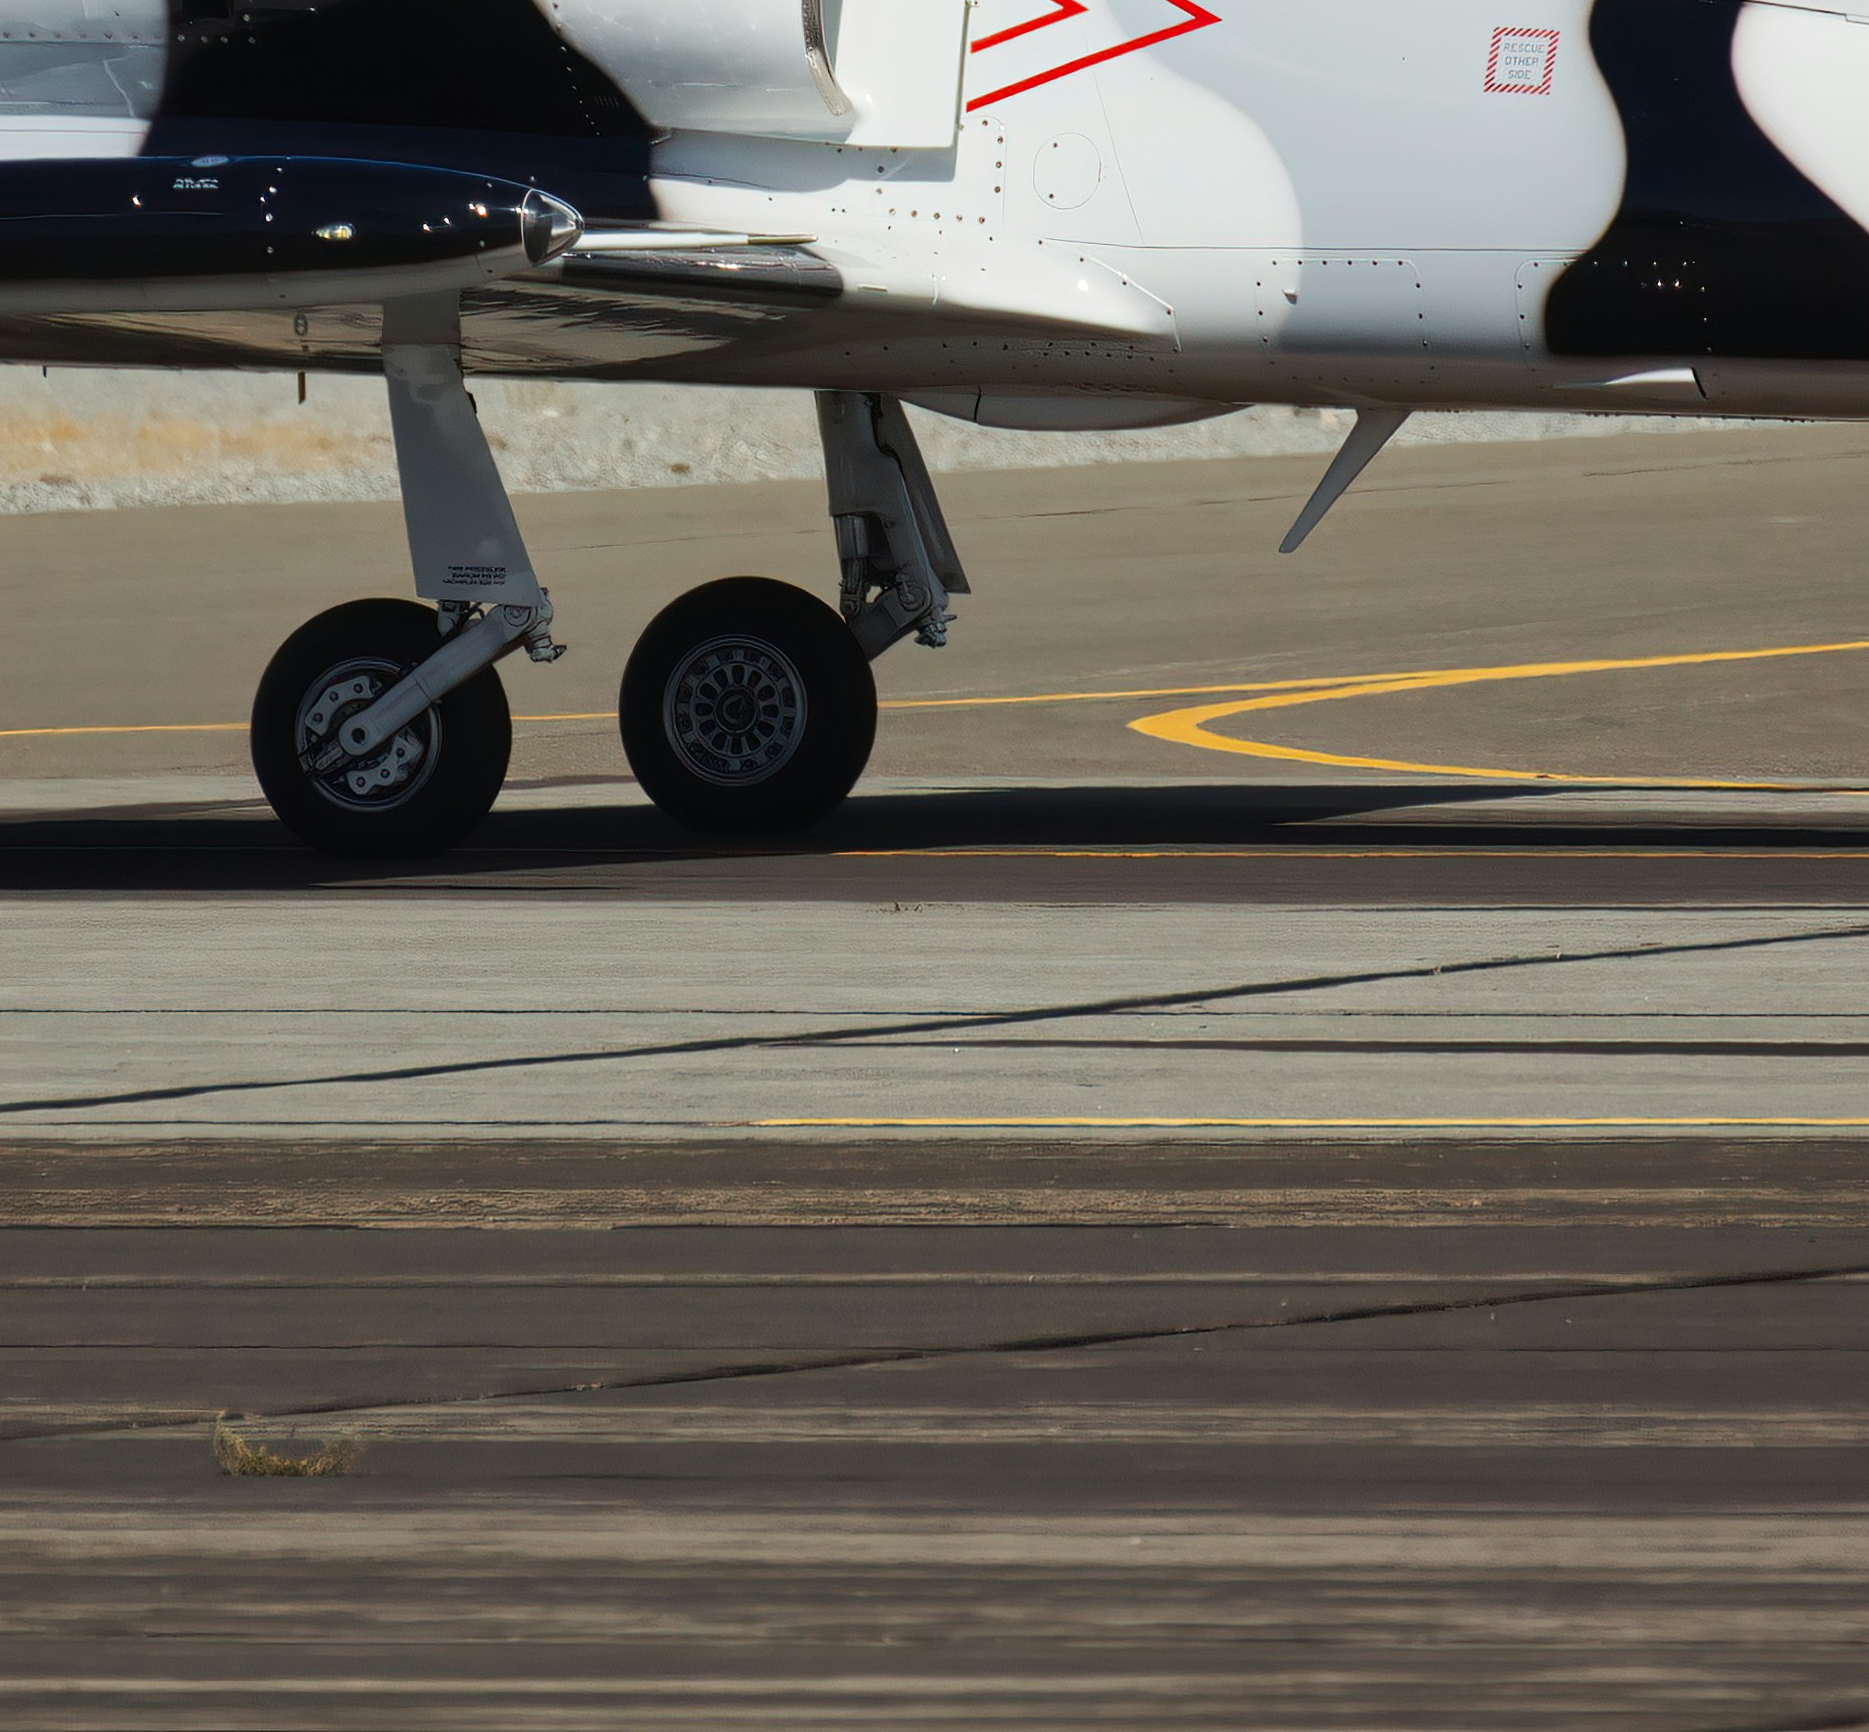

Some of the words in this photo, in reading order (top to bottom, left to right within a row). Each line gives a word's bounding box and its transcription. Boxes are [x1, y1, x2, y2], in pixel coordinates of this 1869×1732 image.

[1502, 42, 1545, 54] RESCUE
[1504, 55, 1539, 67] OTHER
[1507, 69, 1533, 80] SIDE
